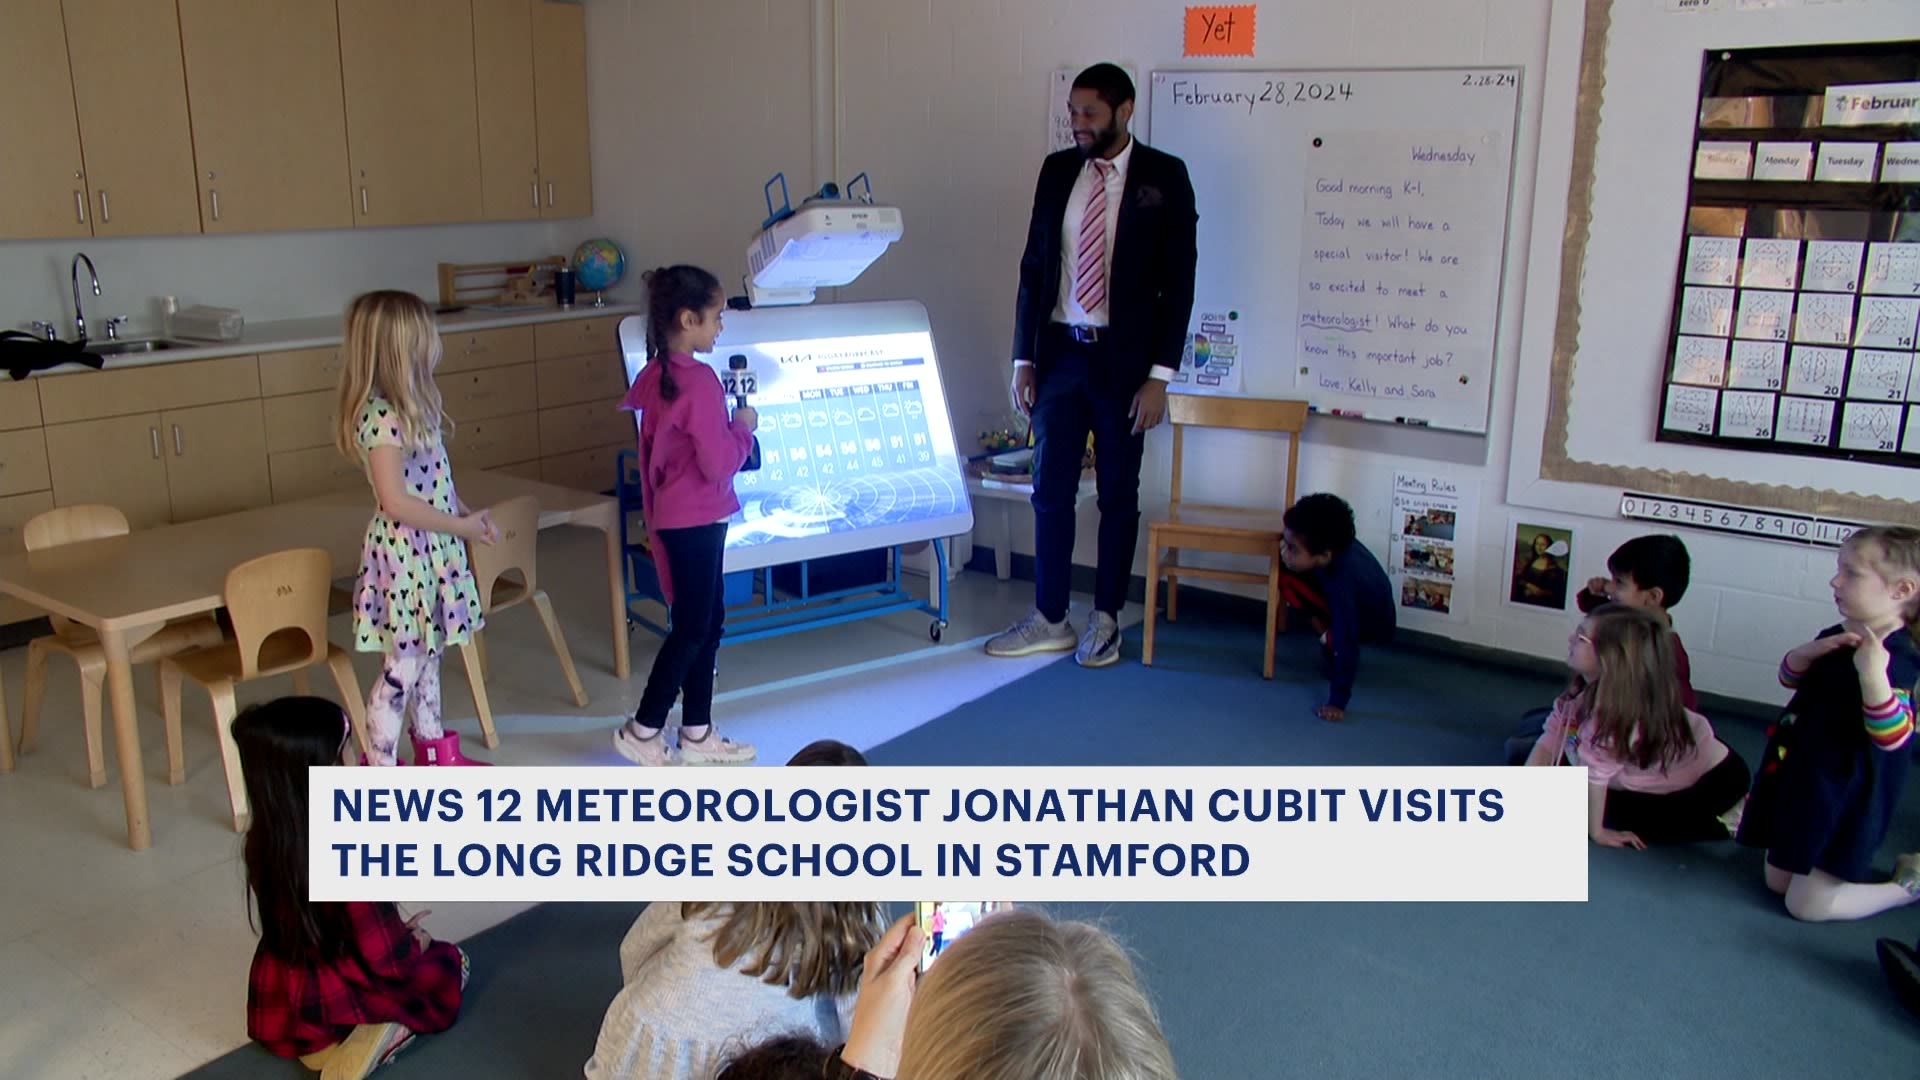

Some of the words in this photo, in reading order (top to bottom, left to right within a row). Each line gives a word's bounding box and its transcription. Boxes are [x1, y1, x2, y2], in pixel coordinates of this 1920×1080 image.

[1200, 13, 1236, 44] Yet
[1172, 81, 1256, 116] February
[1411, 146, 1476, 166] Wednesday
[1764, 156, 1800, 167] Monday
[1828, 156, 1864, 168] Tuesday
[1315, 178, 1343, 194] Good
[1349, 183, 1393, 199] morning
[1315, 211, 1345, 229] Today
[1357, 217, 1371, 228] we
[1381, 215, 1400, 228] will
[1408, 215, 1434, 231] have
[1442, 221, 1451, 232] a
[1313, 249, 1350, 264] special
[1418, 251, 1433, 263] We
[1440, 254, 1459, 266] are
[1309, 281, 1321, 292] so
[1328, 280, 1366, 294] excited
[1376, 281, 1389, 296] to
[1398, 284, 1426, 297] meet
[1439, 289, 1448, 299] a
[1724, 274, 1733, 285] 4
[1785, 277, 1792, 288] 5
[1846, 280, 1855, 291] 6
[1912, 282, 1920, 293] 7
[1387, 314, 1416, 329] What
[1425, 317, 1439, 333] do
[1446, 323, 1468, 336] you
[1715, 324, 1727, 335] 11
[1773, 328, 1787, 340] 12
[1833, 332, 1847, 343] 13
[1897, 336, 1911, 347] 14
[1304, 339, 1329, 356] know
[1337, 343, 1357, 360] this
[1366, 350, 1417, 366] important
[1422, 351, 1454, 369] job?
[741, 377, 756, 394] 12
[803, 390, 822, 400] MON
[1349, 376, 1377, 396] Kelly
[1384, 383, 1405, 397] and
[1708, 373, 1721, 384] 18
[1766, 378, 1780, 389] 19
[1824, 384, 1839, 396] 20
[1887, 389, 1901, 399] 21
[1697, 422, 1711, 433] 25
[1755, 428, 1770, 438] 26
[1813, 434, 1827, 444] 27
[1879, 440, 1894, 451] 28
[770, 468, 784, 481] 42
[796, 465, 809, 478] 42
[822, 462, 834, 474] 42
[847, 459, 860, 471] 44
[917, 450, 930, 463] 39
[1431, 477, 1457, 492] Rules
[1624, 499, 1635, 514] 0
[1640, 501, 1646, 515] 1
[1652, 502, 1662, 517] 2
[1668, 504, 1679, 519] 3
[1685, 506, 1696, 521] 4
[1703, 509, 1713, 523] 5
[1720, 512, 1730, 526] 6
[1738, 514, 1748, 528] 7
[1754, 516, 1765, 530] 8
[1773, 519, 1783, 533] 9
[1790, 522, 1808, 537] 10
[1816, 524, 1828, 539] 11
